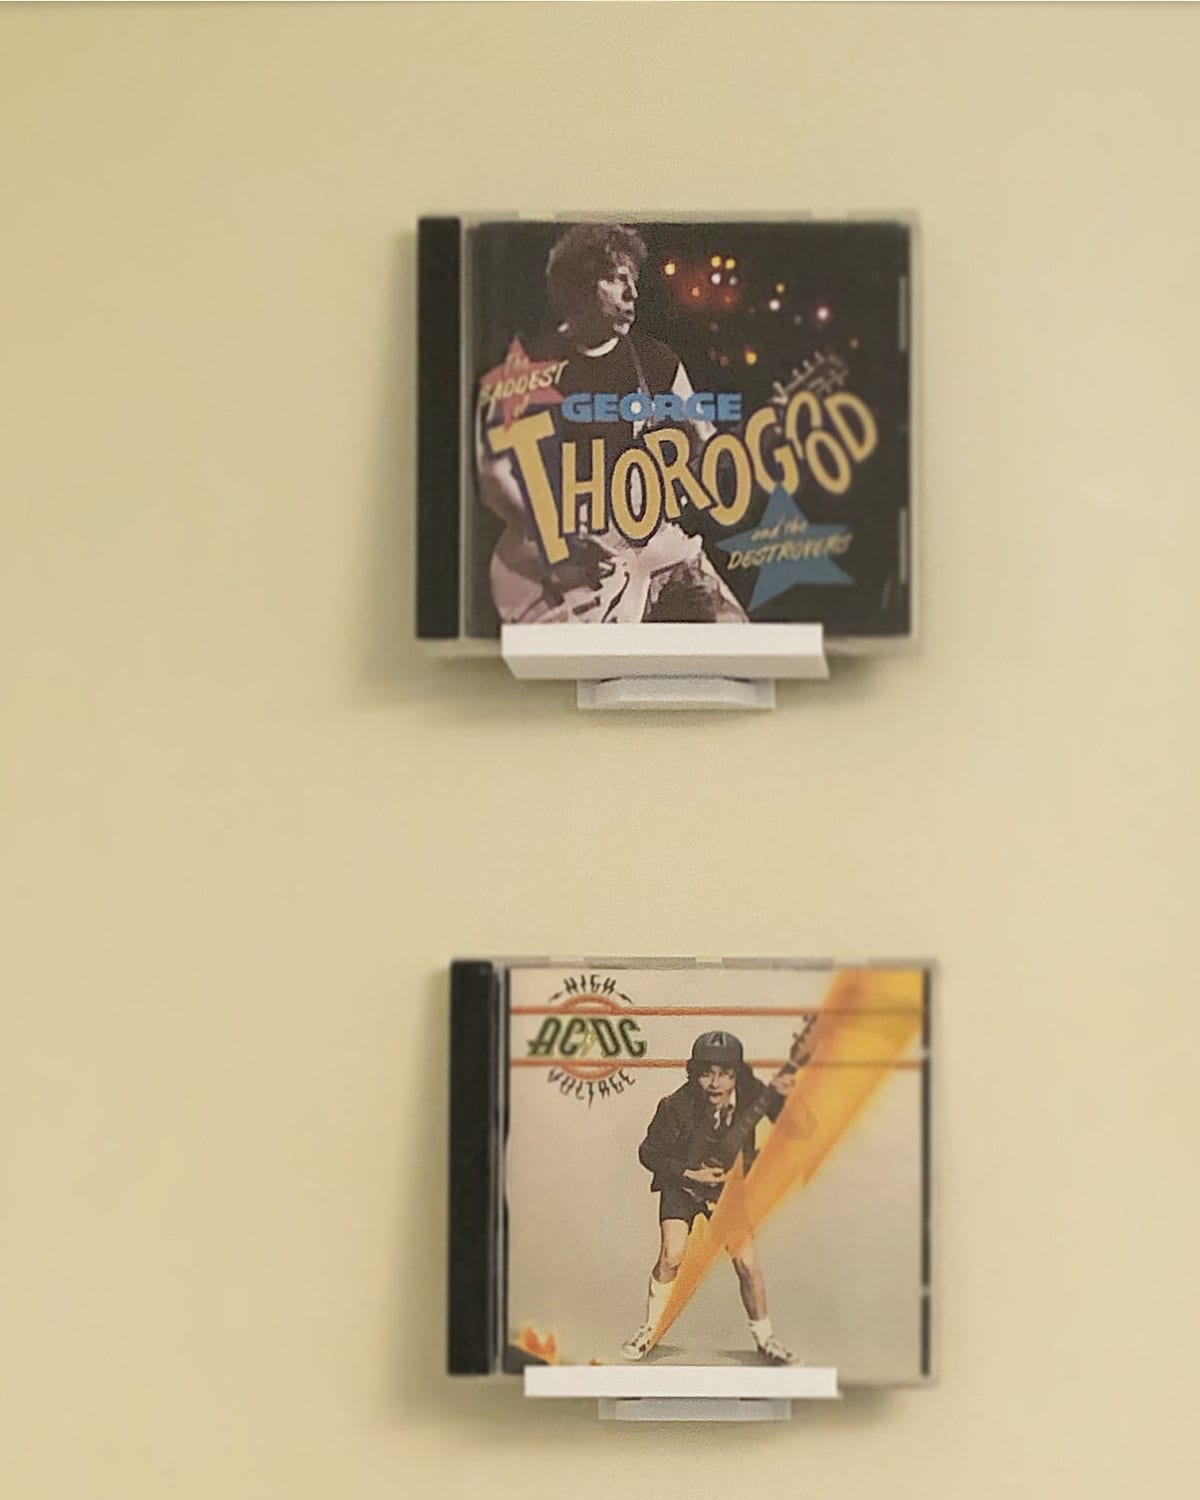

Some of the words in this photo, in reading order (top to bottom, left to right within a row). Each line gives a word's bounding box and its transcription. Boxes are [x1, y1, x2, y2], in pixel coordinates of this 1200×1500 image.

[562, 393, 743, 422] GEORGE
[487, 391, 878, 565] THOROGOOD
[563, 974, 617, 995] HIGH
[547, 1067, 636, 1109] VOLTAGE
